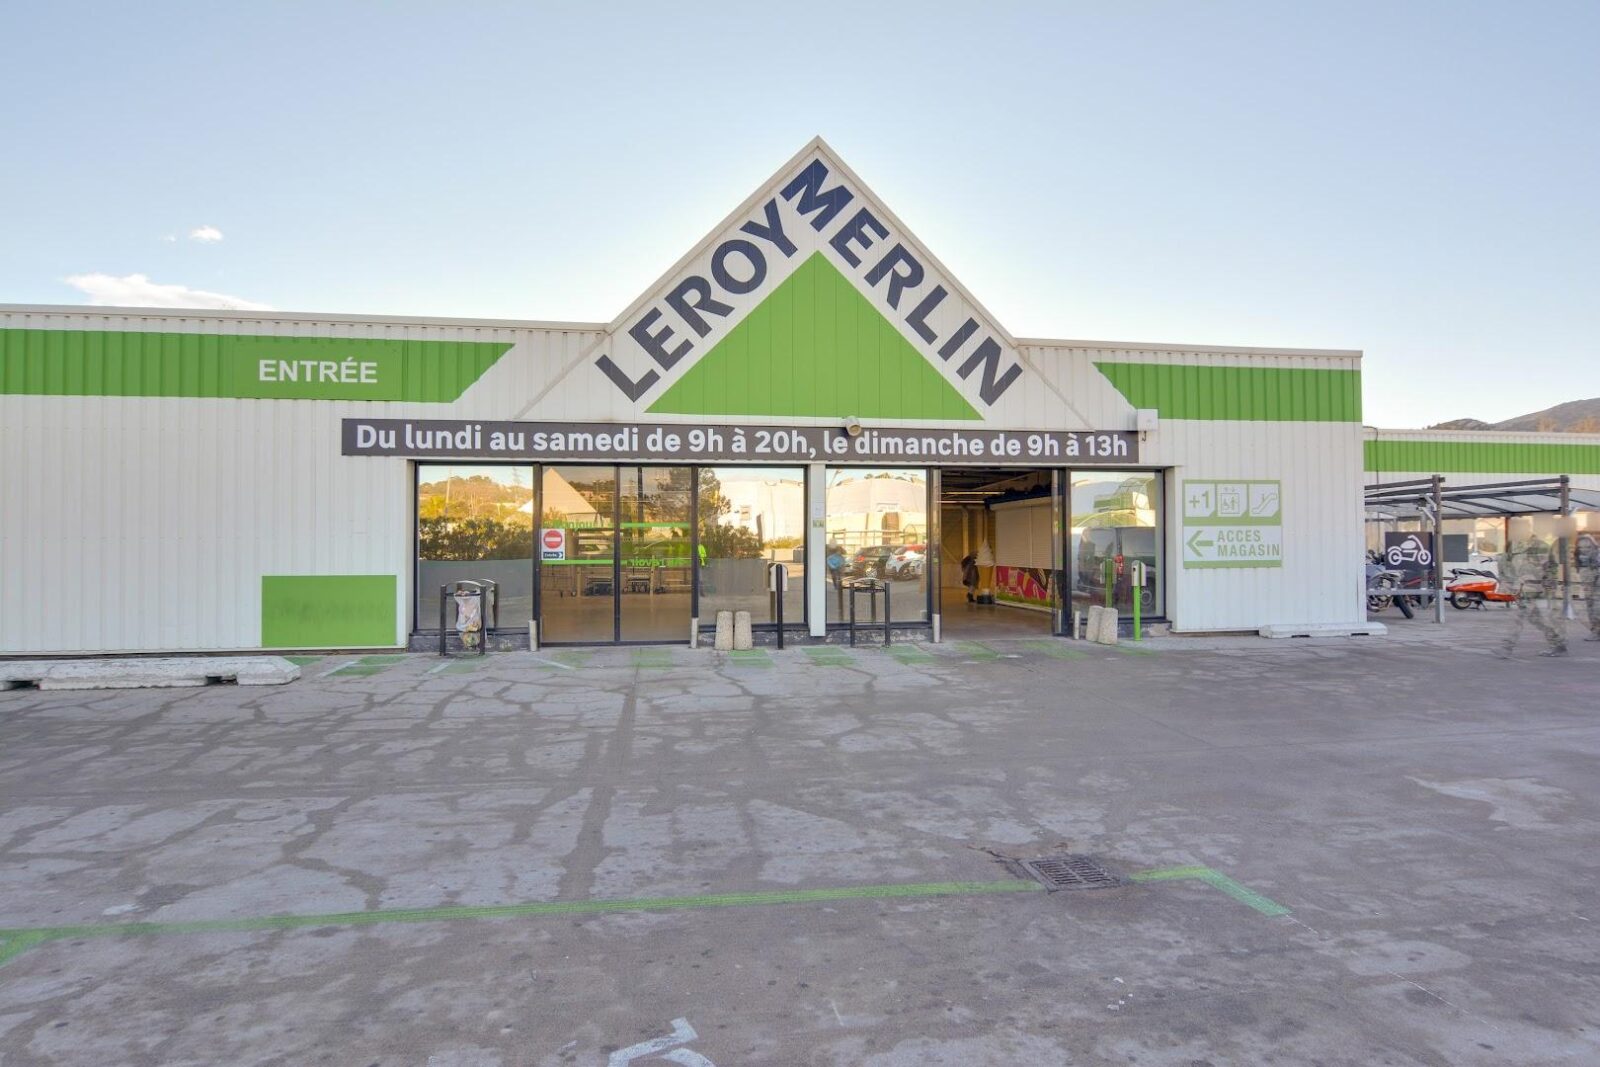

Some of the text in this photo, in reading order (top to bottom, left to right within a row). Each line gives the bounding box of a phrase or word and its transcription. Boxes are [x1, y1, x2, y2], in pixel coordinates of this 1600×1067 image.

[594, 158, 1024, 407] LEROY MERLIN
[259, 356, 378, 383] ENTRÉE
[356, 424, 1128, 459] Du lundi au samedi de 9h à 20h, le dimanche de 9h à 13h
[1217, 530, 1260, 543] ACCES
[1217, 544, 1280, 557] MAGASIN
